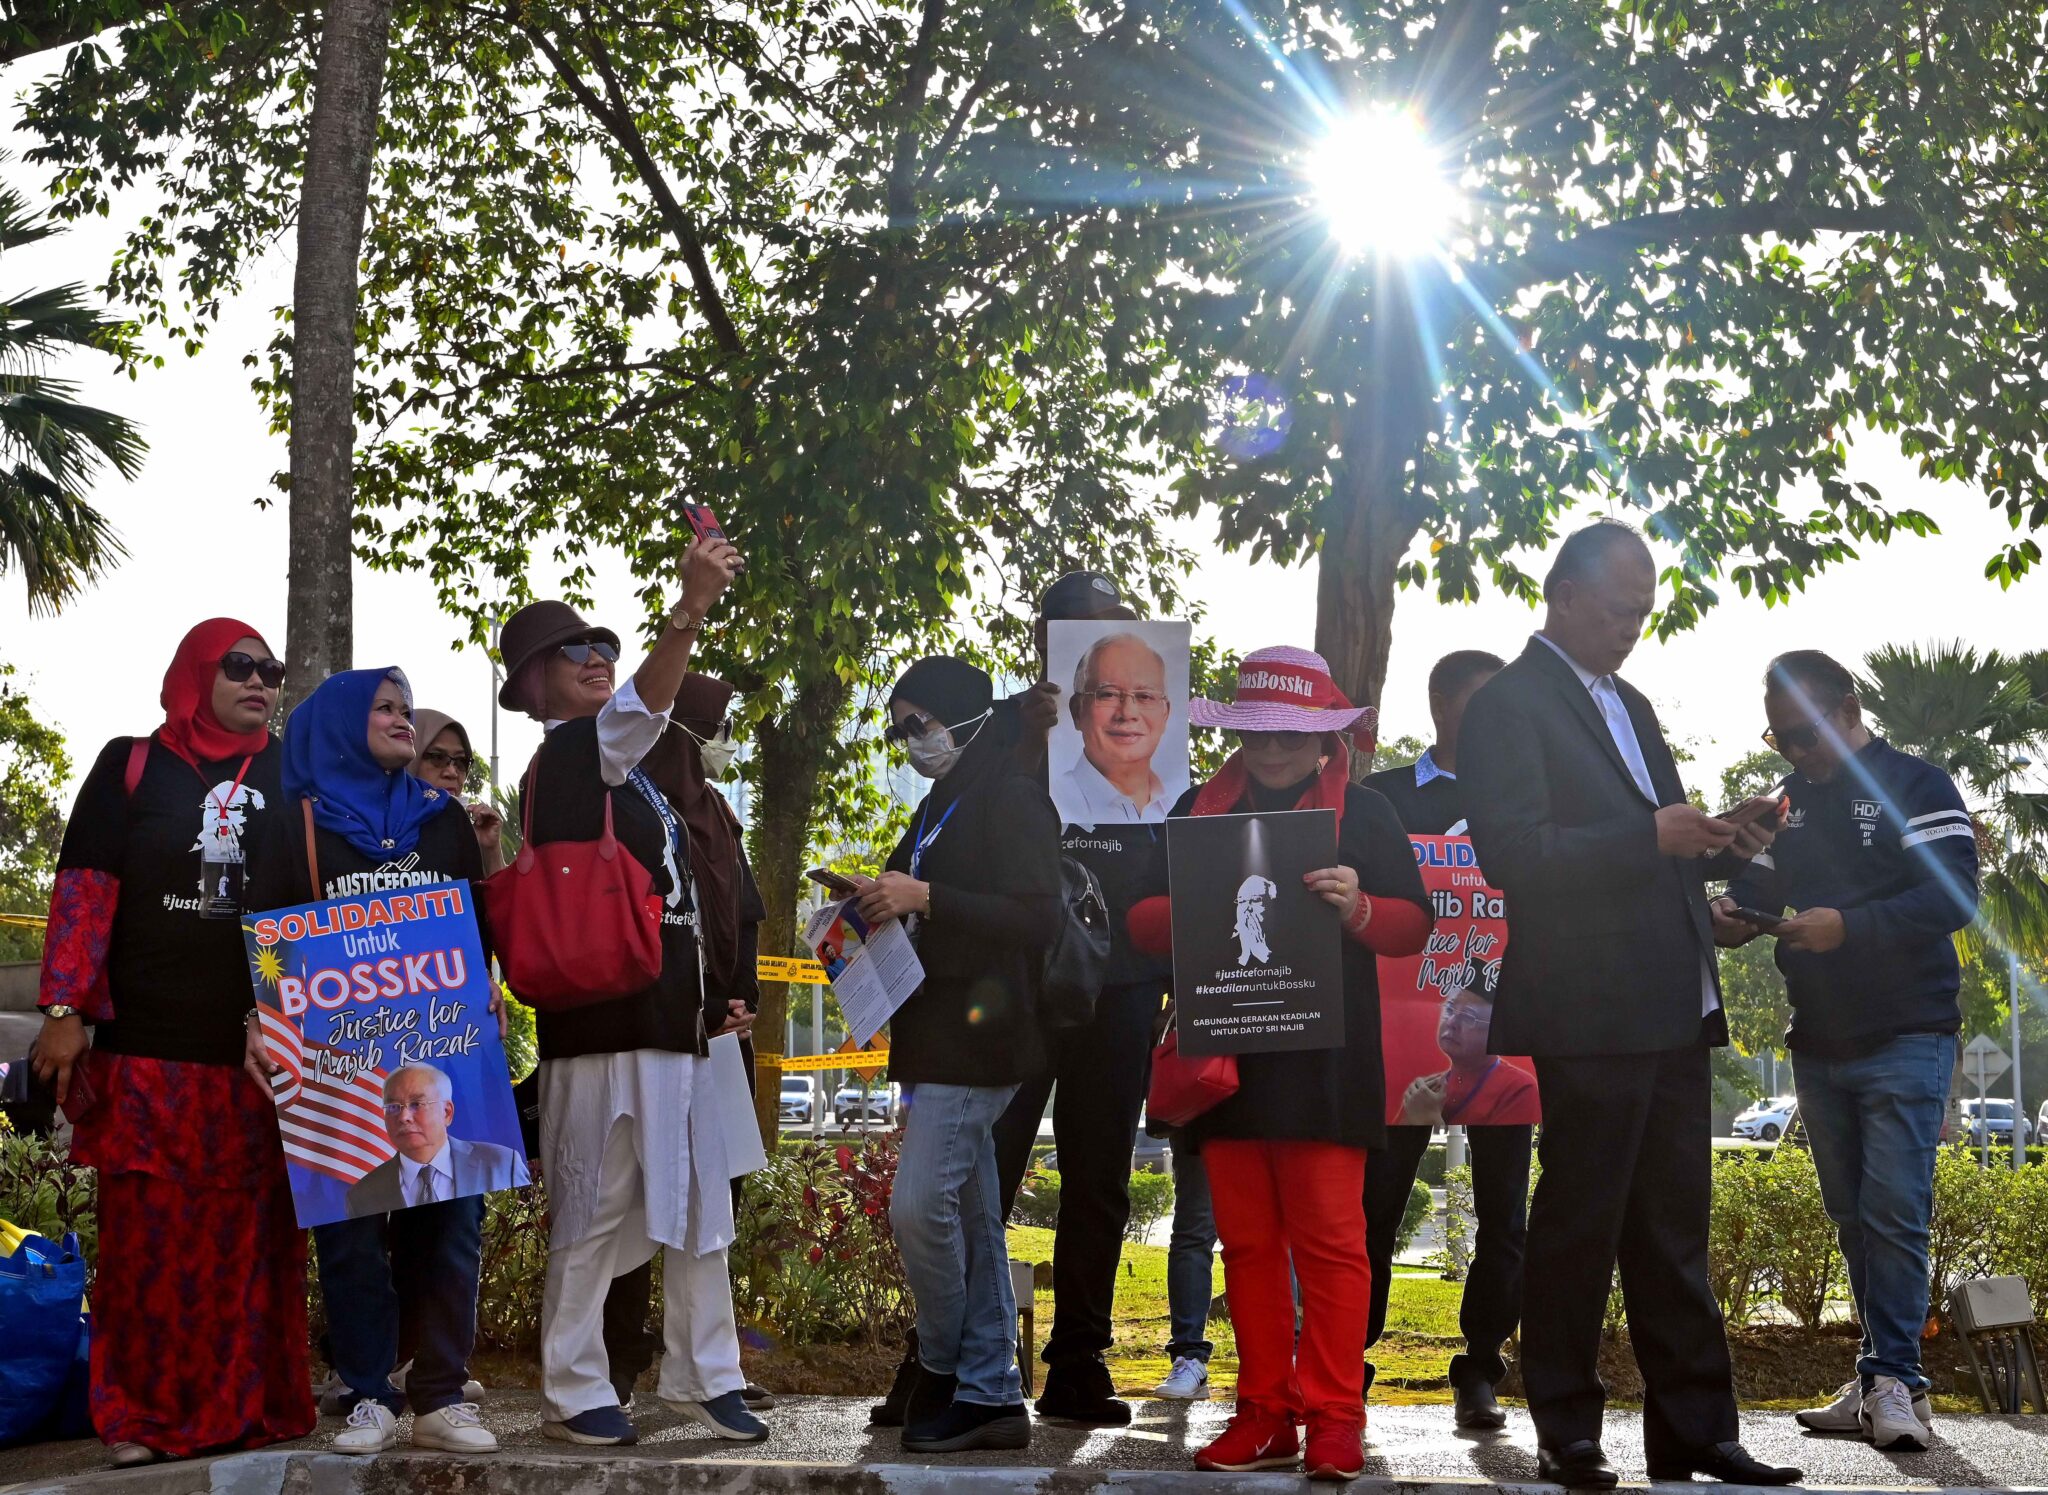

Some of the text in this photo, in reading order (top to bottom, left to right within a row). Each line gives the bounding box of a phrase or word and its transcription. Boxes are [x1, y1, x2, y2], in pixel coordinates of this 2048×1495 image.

[1239, 671, 1313, 697] basBossku
[642, 776, 667, 815] PENINSULAR
[664, 815, 675, 833] 2019
[1062, 837, 1122, 852] cefornajib
[1411, 842, 1480, 868] OLID
[1452, 873, 1486, 887] Untu
[255, 888, 464, 946] SOLIDARITI
[1431, 889, 1506, 921] jib Ra
[343, 928, 401, 958] Untuk
[1464, 925, 1498, 958] for
[277, 948, 467, 1018] BOSSKU
[1195, 979, 1316, 995] #keadilanuntukBossku
[1215, 966, 1292, 981] #justicefornajib
[1417, 958, 1476, 997] Najib
[328, 996, 467, 1046] Justice for
[1193, 1012, 1321, 1026] GABUNGAN GERAKAN KEADILAN
[1210, 1027, 1239, 1036] UNTUK
[1280, 1023, 1304, 1031] NAJIB
[314, 1024, 479, 1084] Najib Razak
